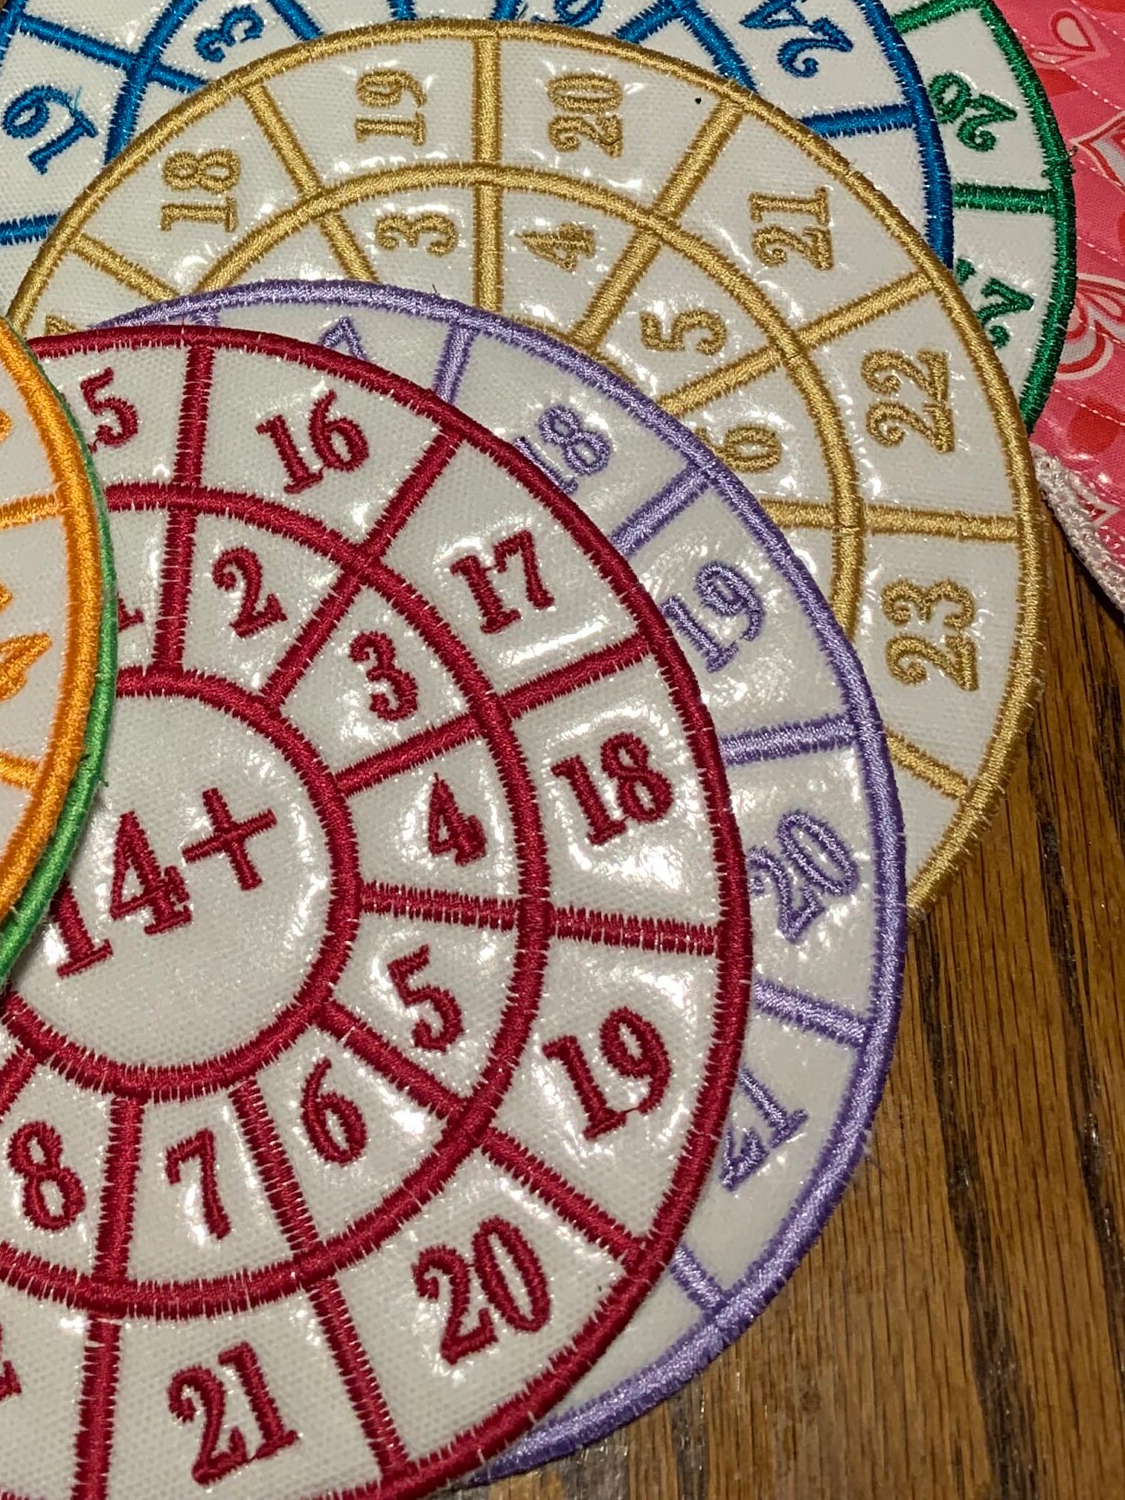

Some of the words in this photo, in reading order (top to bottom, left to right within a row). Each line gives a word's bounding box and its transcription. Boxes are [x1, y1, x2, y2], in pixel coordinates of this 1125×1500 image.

[194, 4, 265, 64] 3
[547, 72, 624, 159] 20
[160, 148, 242, 233] 18
[375, 212, 458, 256] 3
[749, 186, 835, 271] 21
[516, 222, 597, 272] 4
[640, 309, 728, 356] 5
[81, 366, 139, 452] 5
[256, 389, 369, 493] 16
[860, 347, 956, 454] 22
[213, 548, 287, 638] 2
[452, 530, 554, 634] 17
[349, 632, 418, 722] 3
[881, 578, 977, 692] 23
[428, 774, 488, 867] 4
[552, 733, 673, 846] 18
[745, 810, 860, 943] 20
[387, 945, 463, 1052] 5
[300, 1058, 367, 1166] 6
[543, 1007, 673, 1141] 19
[7, 1120, 85, 1232] 8
[165, 1129, 231, 1240] 7
[412, 1216, 550, 1366] 20
[167, 1342, 300, 1486] 21
